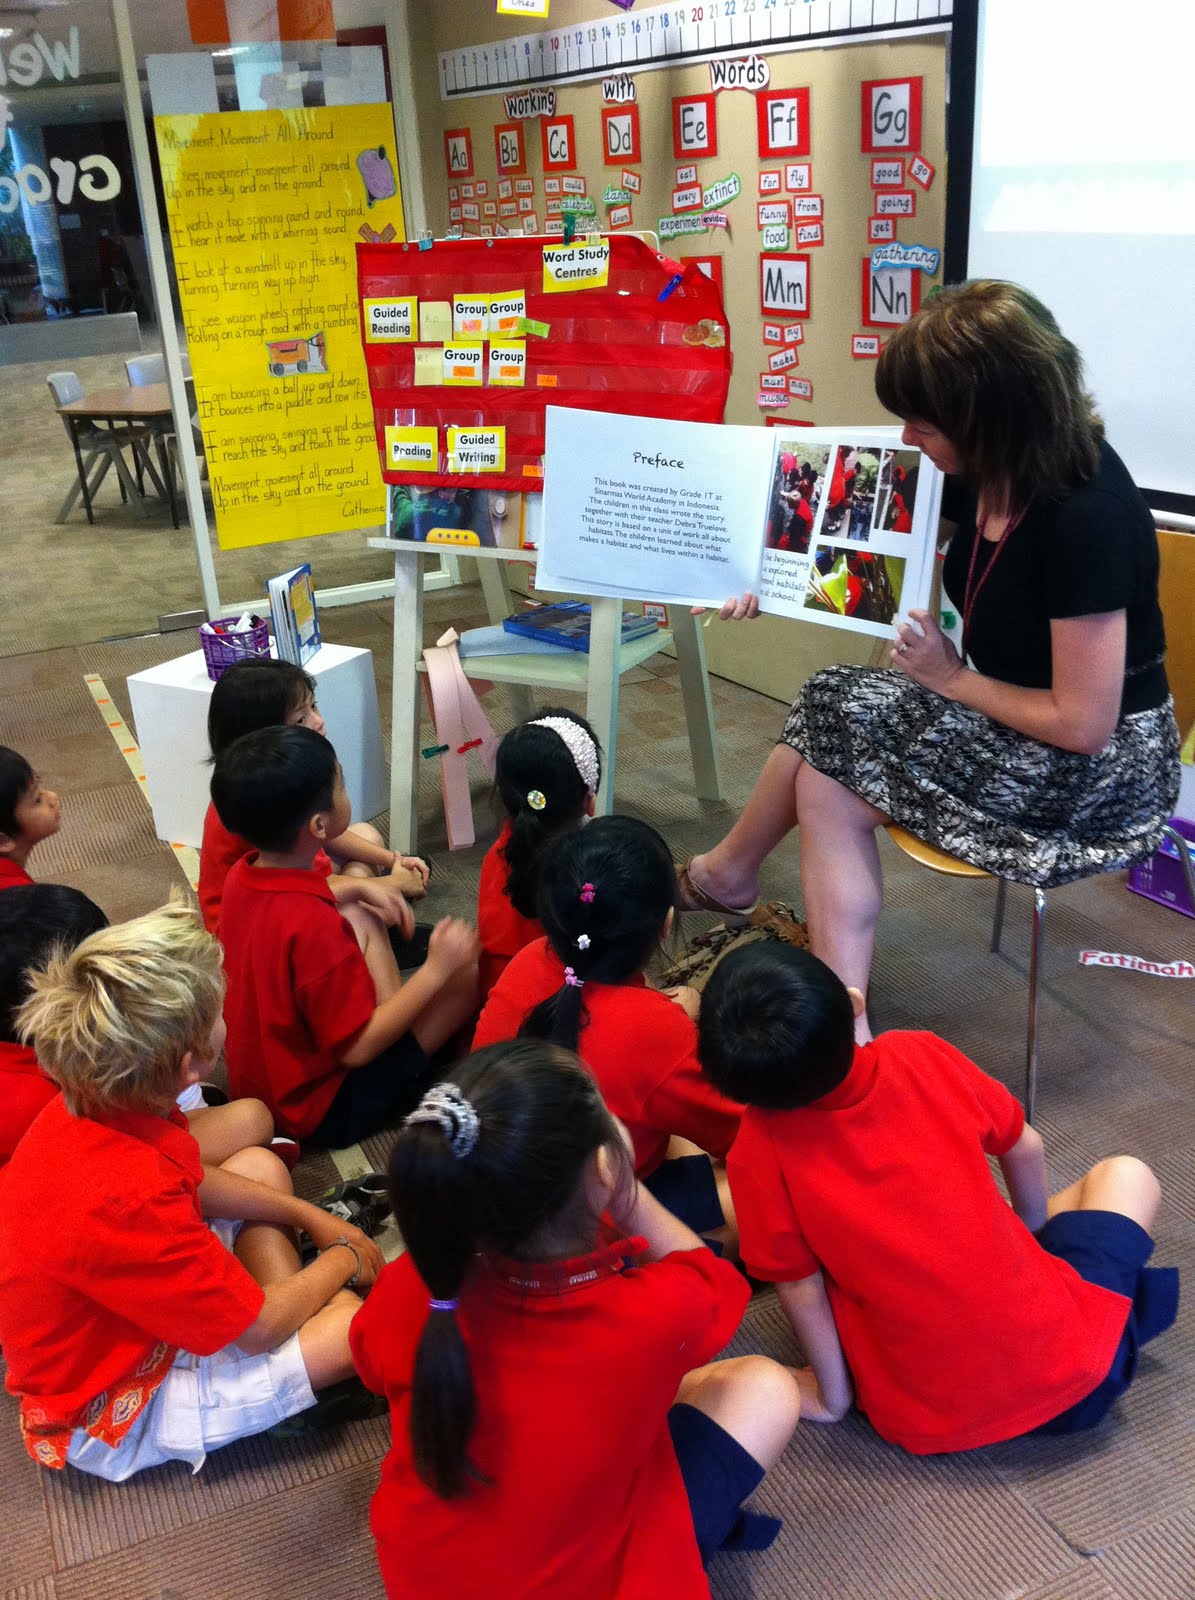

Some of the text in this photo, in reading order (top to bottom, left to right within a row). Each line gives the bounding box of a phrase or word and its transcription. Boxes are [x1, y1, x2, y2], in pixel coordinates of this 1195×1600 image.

[524, 42, 530, 54] 8
[550, 37, 559, 50] 10
[564, 35, 571, 48] 11
[575, 31, 583, 45] 12
[588, 28, 597, 43] 13
[602, 26, 611, 39] 14
[616, 24, 626, 37] 15
[631, 19, 641, 34] 16
[646, 16, 654, 31] 17
[660, 13, 669, 28] 18
[675, 10, 685, 24] 19
[692, 7, 703, 22] 20
[709, 4, 719, 19] 21
[725, 1, 736, 16] 22
[744, 0, 755, 12] 23
[711, 57, 765, 84] Words
[604, 76, 635, 99] with
[506, 90, 554, 116] Working
[682, 107, 706, 144] Ee
[770, 103, 796, 142] Ff
[874, 92, 907, 143] Gg
[277, 125, 291, 143] All
[298, 122, 334, 141] Around
[608, 121, 630, 153] Dd
[501, 135, 518, 164] Bb
[550, 129, 567, 159] Cc
[451, 143, 467, 168] Aa
[680, 169, 692, 179] eat
[790, 170, 803, 186] fly
[875, 164, 900, 182] good
[914, 164, 927, 176] go
[763, 176, 777, 187] for
[678, 192, 696, 203] every
[704, 177, 737, 205] extinct
[797, 201, 818, 212] from
[880, 197, 910, 212] going
[760, 208, 787, 223] funny
[765, 228, 786, 244] food
[798, 229, 820, 241] find
[873, 221, 889, 237] get
[544, 248, 609, 263] Word Study
[874, 247, 936, 270] gathering
[555, 266, 597, 279] Centres
[765, 267, 802, 304] Mm
[872, 276, 907, 315] Nn
[374, 307, 408, 318] Guided
[456, 303, 488, 316] Group
[490, 302, 524, 314] Group
[372, 323, 410, 335] Reading
[856, 340, 876, 349] now
[445, 350, 480, 362] Group
[491, 350, 524, 363] Group
[460, 435, 494, 444] Guided
[459, 452, 495, 464] Writing
[633, 452, 684, 468] Preface
[310, 463, 319, 479] all
[325, 460, 354, 475] around
[264, 488, 280, 506] sky
[594, 477, 607, 486] This
[610, 480, 626, 489] book
[643, 485, 668, 494] created
[680, 489, 701, 499] Grade
[594, 487, 622, 498] Sinarmas
[624, 492, 646, 501] World
[646, 495, 676, 507] Academy
[585, 507, 612, 516] together
[631, 512, 646, 521] their
[648, 515, 672, 525] teacher
[675, 519, 696, 528] Debra
[589, 497, 601, 505] The
[604, 499, 629, 509] children
[654, 506, 668, 514] class
[671, 509, 690, 518] wrote
[693, 511, 703, 519] the
[706, 514, 725, 522] story
[581, 515, 594, 523] This
[596, 519, 613, 527] story
[622, 521, 640, 530] based
[659, 527, 671, 535] unit
[682, 531, 700, 539] work
[711, 534, 731, 543] about
[579, 535, 598, 544] makes
[606, 539, 628, 548] habitat
[661, 547, 675, 556] lives
[678, 550, 698, 558] within
[615, 530, 627, 538] The
[629, 532, 655, 542] children
[657, 536, 682, 546] learned
[684, 539, 703, 548] about
[705, 543, 721, 552] what
[1082, 951, 1193, 975] Fatimah
